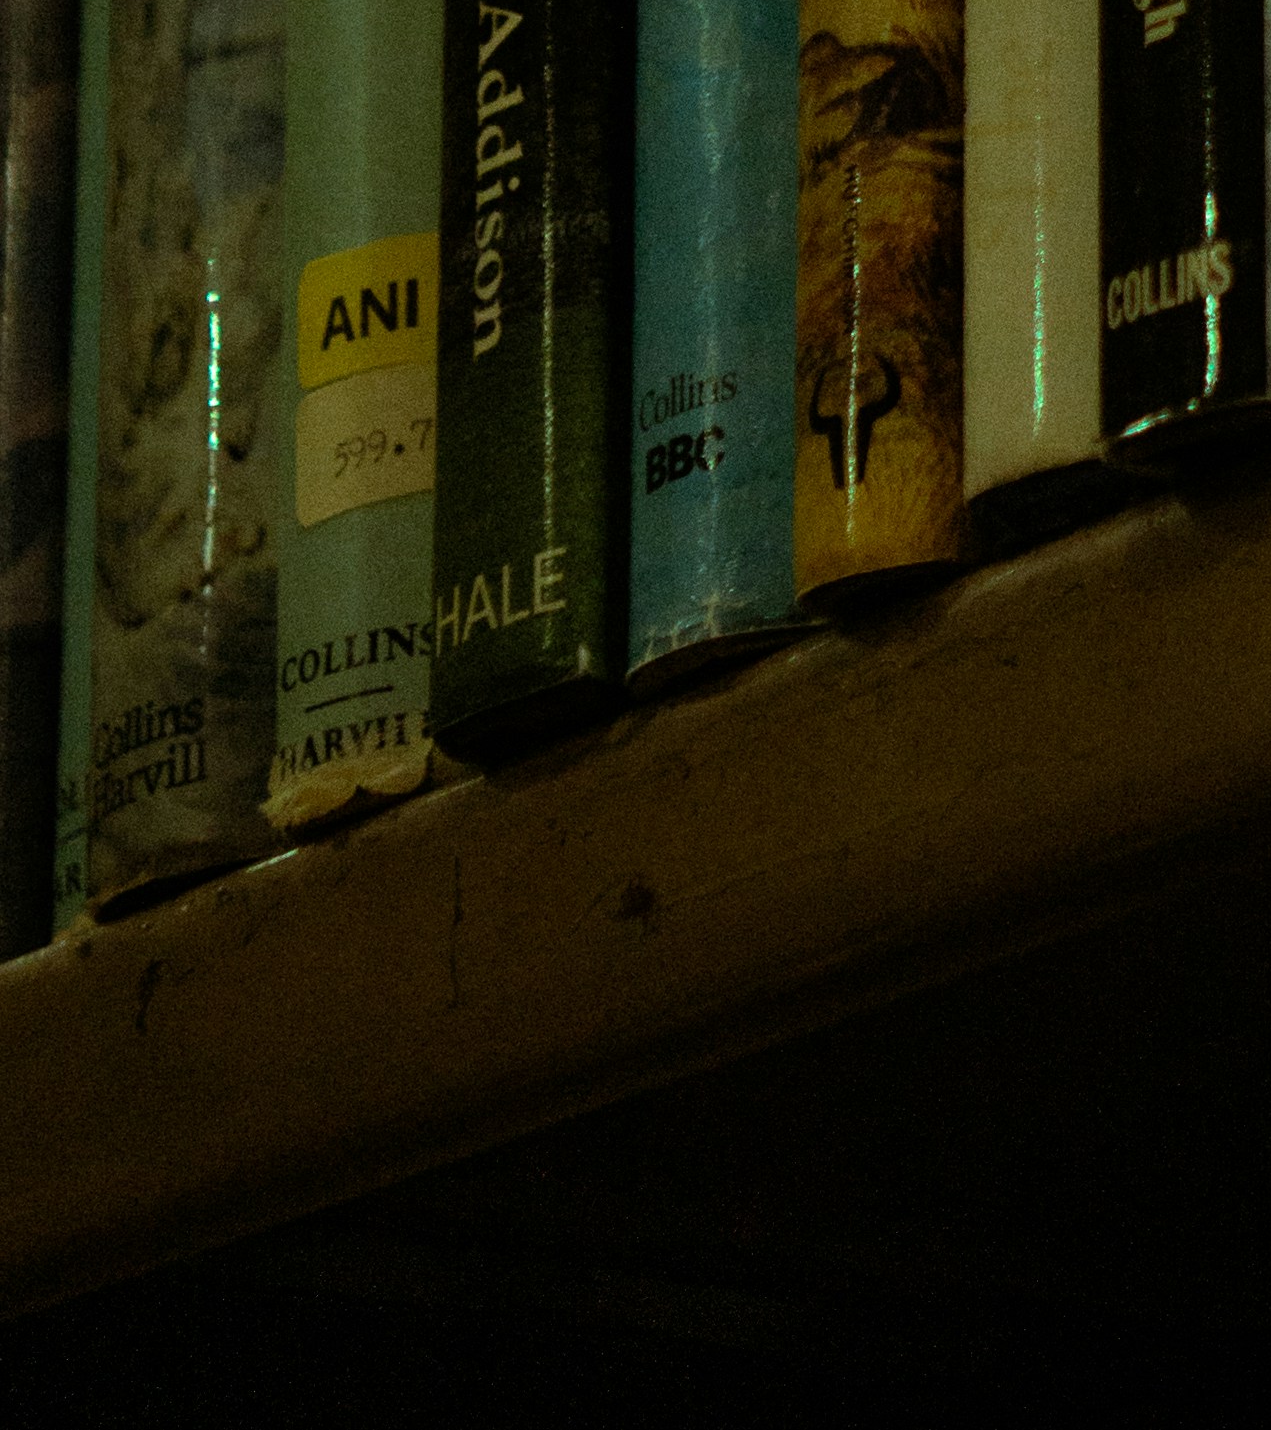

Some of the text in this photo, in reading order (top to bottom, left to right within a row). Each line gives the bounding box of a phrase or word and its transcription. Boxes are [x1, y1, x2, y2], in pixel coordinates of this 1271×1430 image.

[472, 1, 526, 359] Addison
[320, 277, 420, 351] ANI
[1106, 239, 1234, 331] COLLINS
[638, 369, 738, 433] Collins
[644, 427, 724, 493] BBC
[434, 549, 568, 657] HALE
[280, 623, 434, 693] COLLINS
[94, 695, 204, 769] Collins
[90, 739, 208, 815] Harvill
